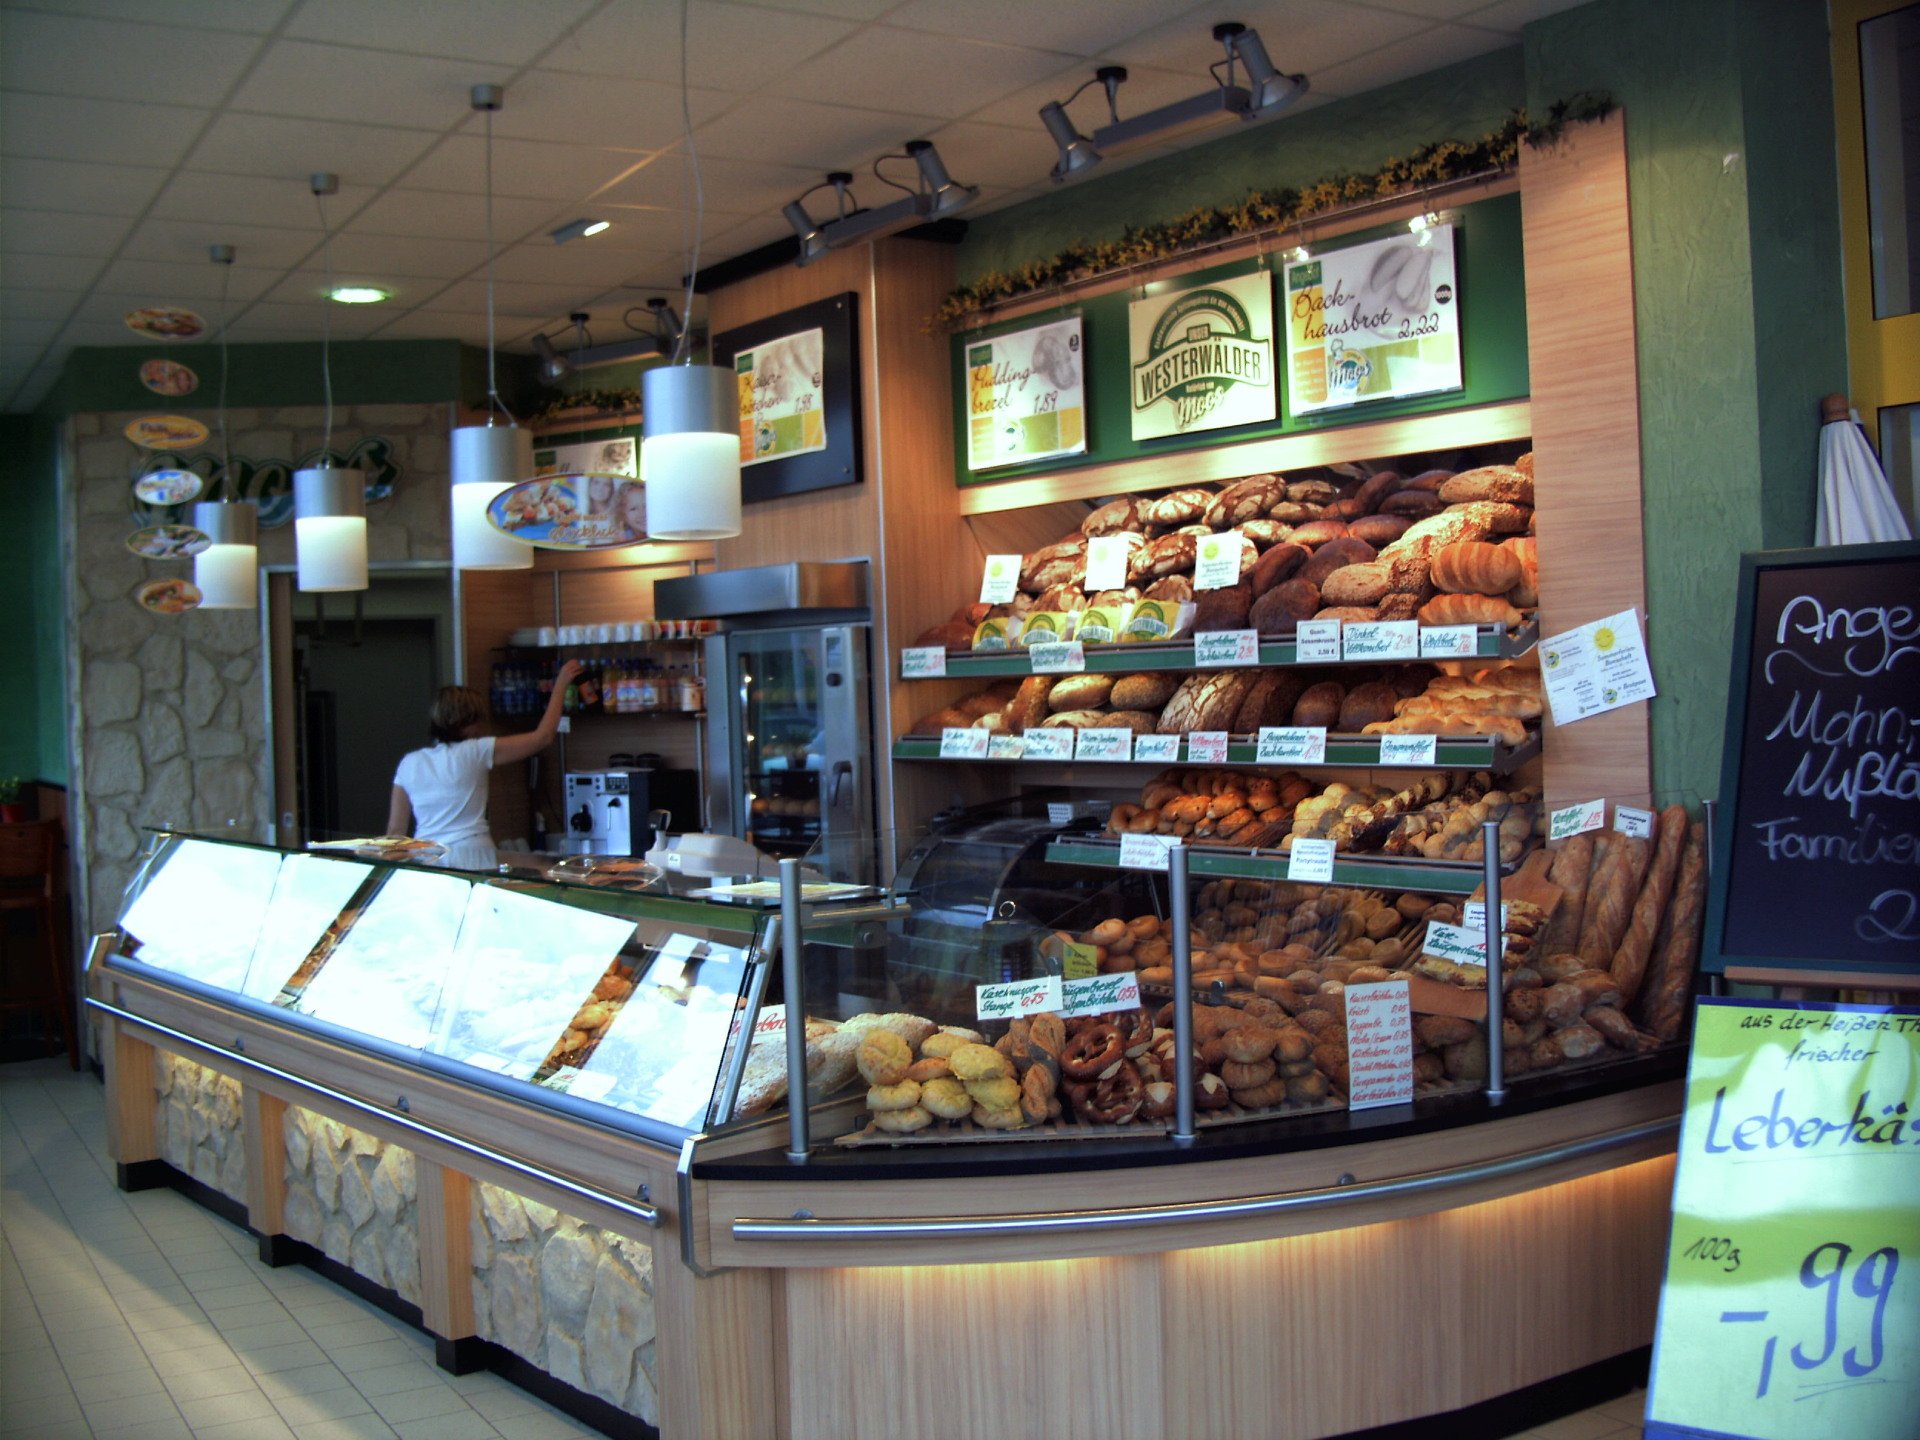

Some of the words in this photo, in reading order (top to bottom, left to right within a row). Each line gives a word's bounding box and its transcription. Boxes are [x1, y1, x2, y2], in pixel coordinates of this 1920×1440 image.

[1292, 279, 1356, 321] Back-
[1304, 304, 1392, 341] hausbrot
[1398, 313, 1440, 339] 2,22
[1141, 336, 1261, 402] WESTERWÄLDER
[1752, 813, 1920, 865] Familie
[1740, 1013, 1773, 1030] aus
[1779, 1012, 1820, 1031] der
[1784, 1039, 1880, 1071] frischer
[1683, 1236, 1741, 1273] 100g
